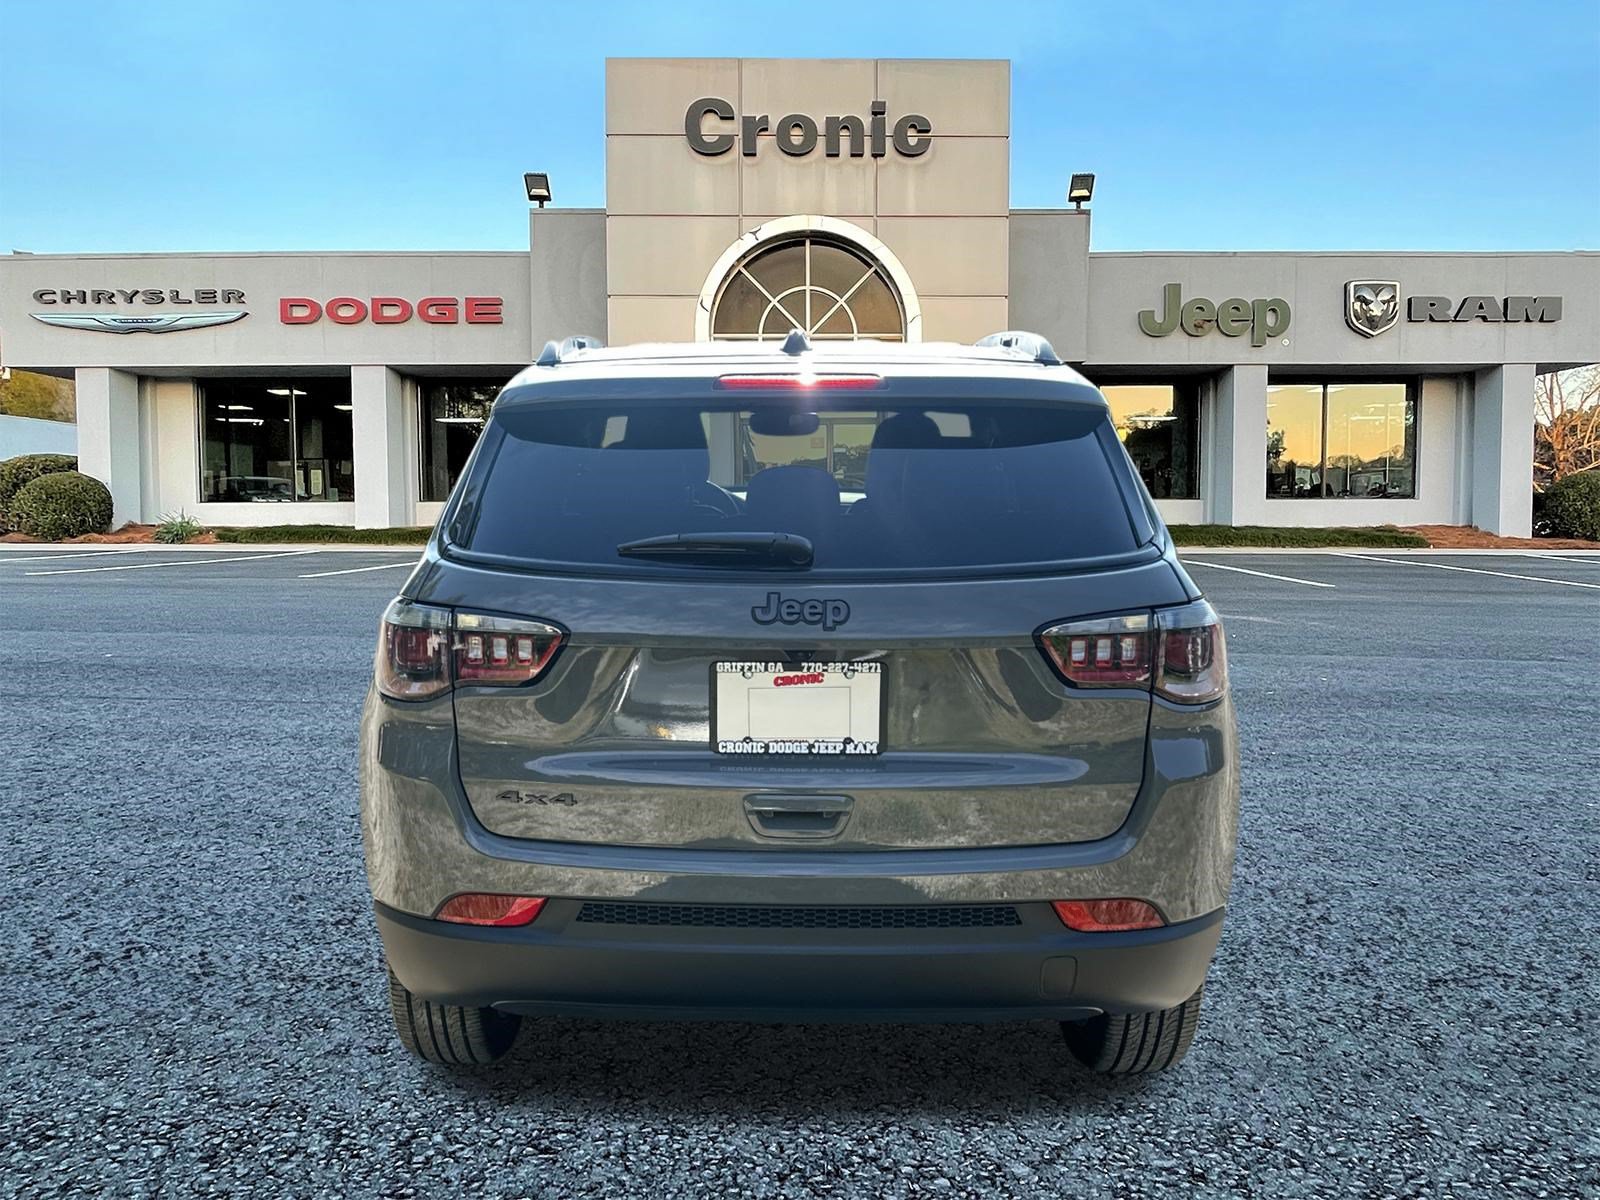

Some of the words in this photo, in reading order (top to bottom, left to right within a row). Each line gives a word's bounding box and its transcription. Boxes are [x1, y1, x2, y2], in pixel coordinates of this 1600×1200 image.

[684, 97, 933, 157] Cronic
[31, 287, 247, 306] CHRYSLER
[279, 296, 504, 325] DODGE
[1138, 282, 1292, 347] Jeep
[1407, 295, 1563, 324] RAM
[751, 592, 850, 631] Jeep
[716, 662, 765, 673] GRIFFIN
[767, 662, 784, 673] GA
[801, 662, 882, 673] 770-227-4271
[773, 672, 825, 687] CRONIC
[718, 742, 765, 754] CRONIC
[768, 742, 809, 754] DODGE
[811, 742, 844, 754] JEEP
[844, 742, 878, 754] RAM
[495, 790, 578, 806] 4x4
